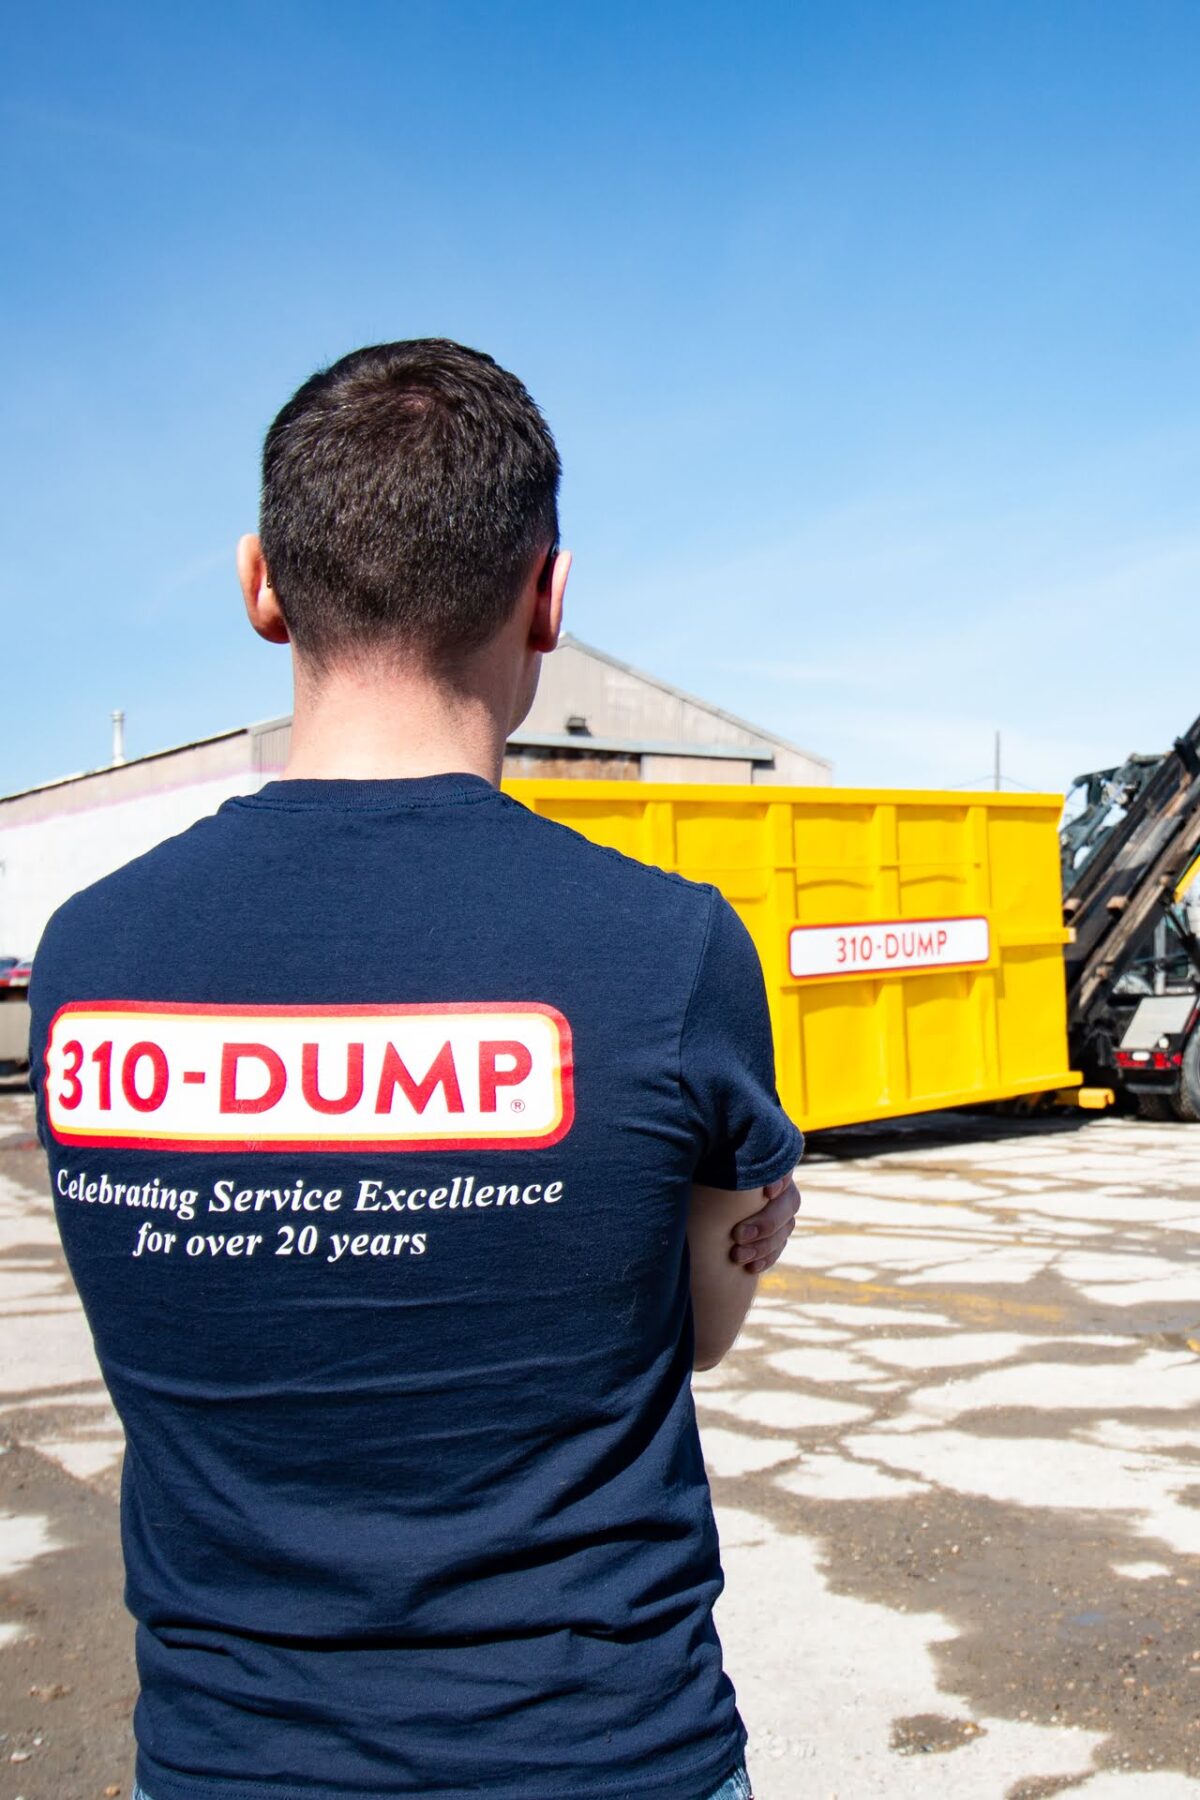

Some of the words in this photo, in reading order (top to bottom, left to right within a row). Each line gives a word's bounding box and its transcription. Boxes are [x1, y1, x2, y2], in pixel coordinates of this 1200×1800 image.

[836, 930, 947, 963] 310-DUMP
[58, 1039, 533, 1115] 310-DUMP
[57, 1169, 198, 1219] Celebrating
[208, 1180, 342, 1212] Service
[355, 1176, 563, 1213] Excellence
[132, 1222, 177, 1257] for
[186, 1233, 262, 1256] over
[274, 1225, 318, 1256] 20
[328, 1232, 427, 1263] years
